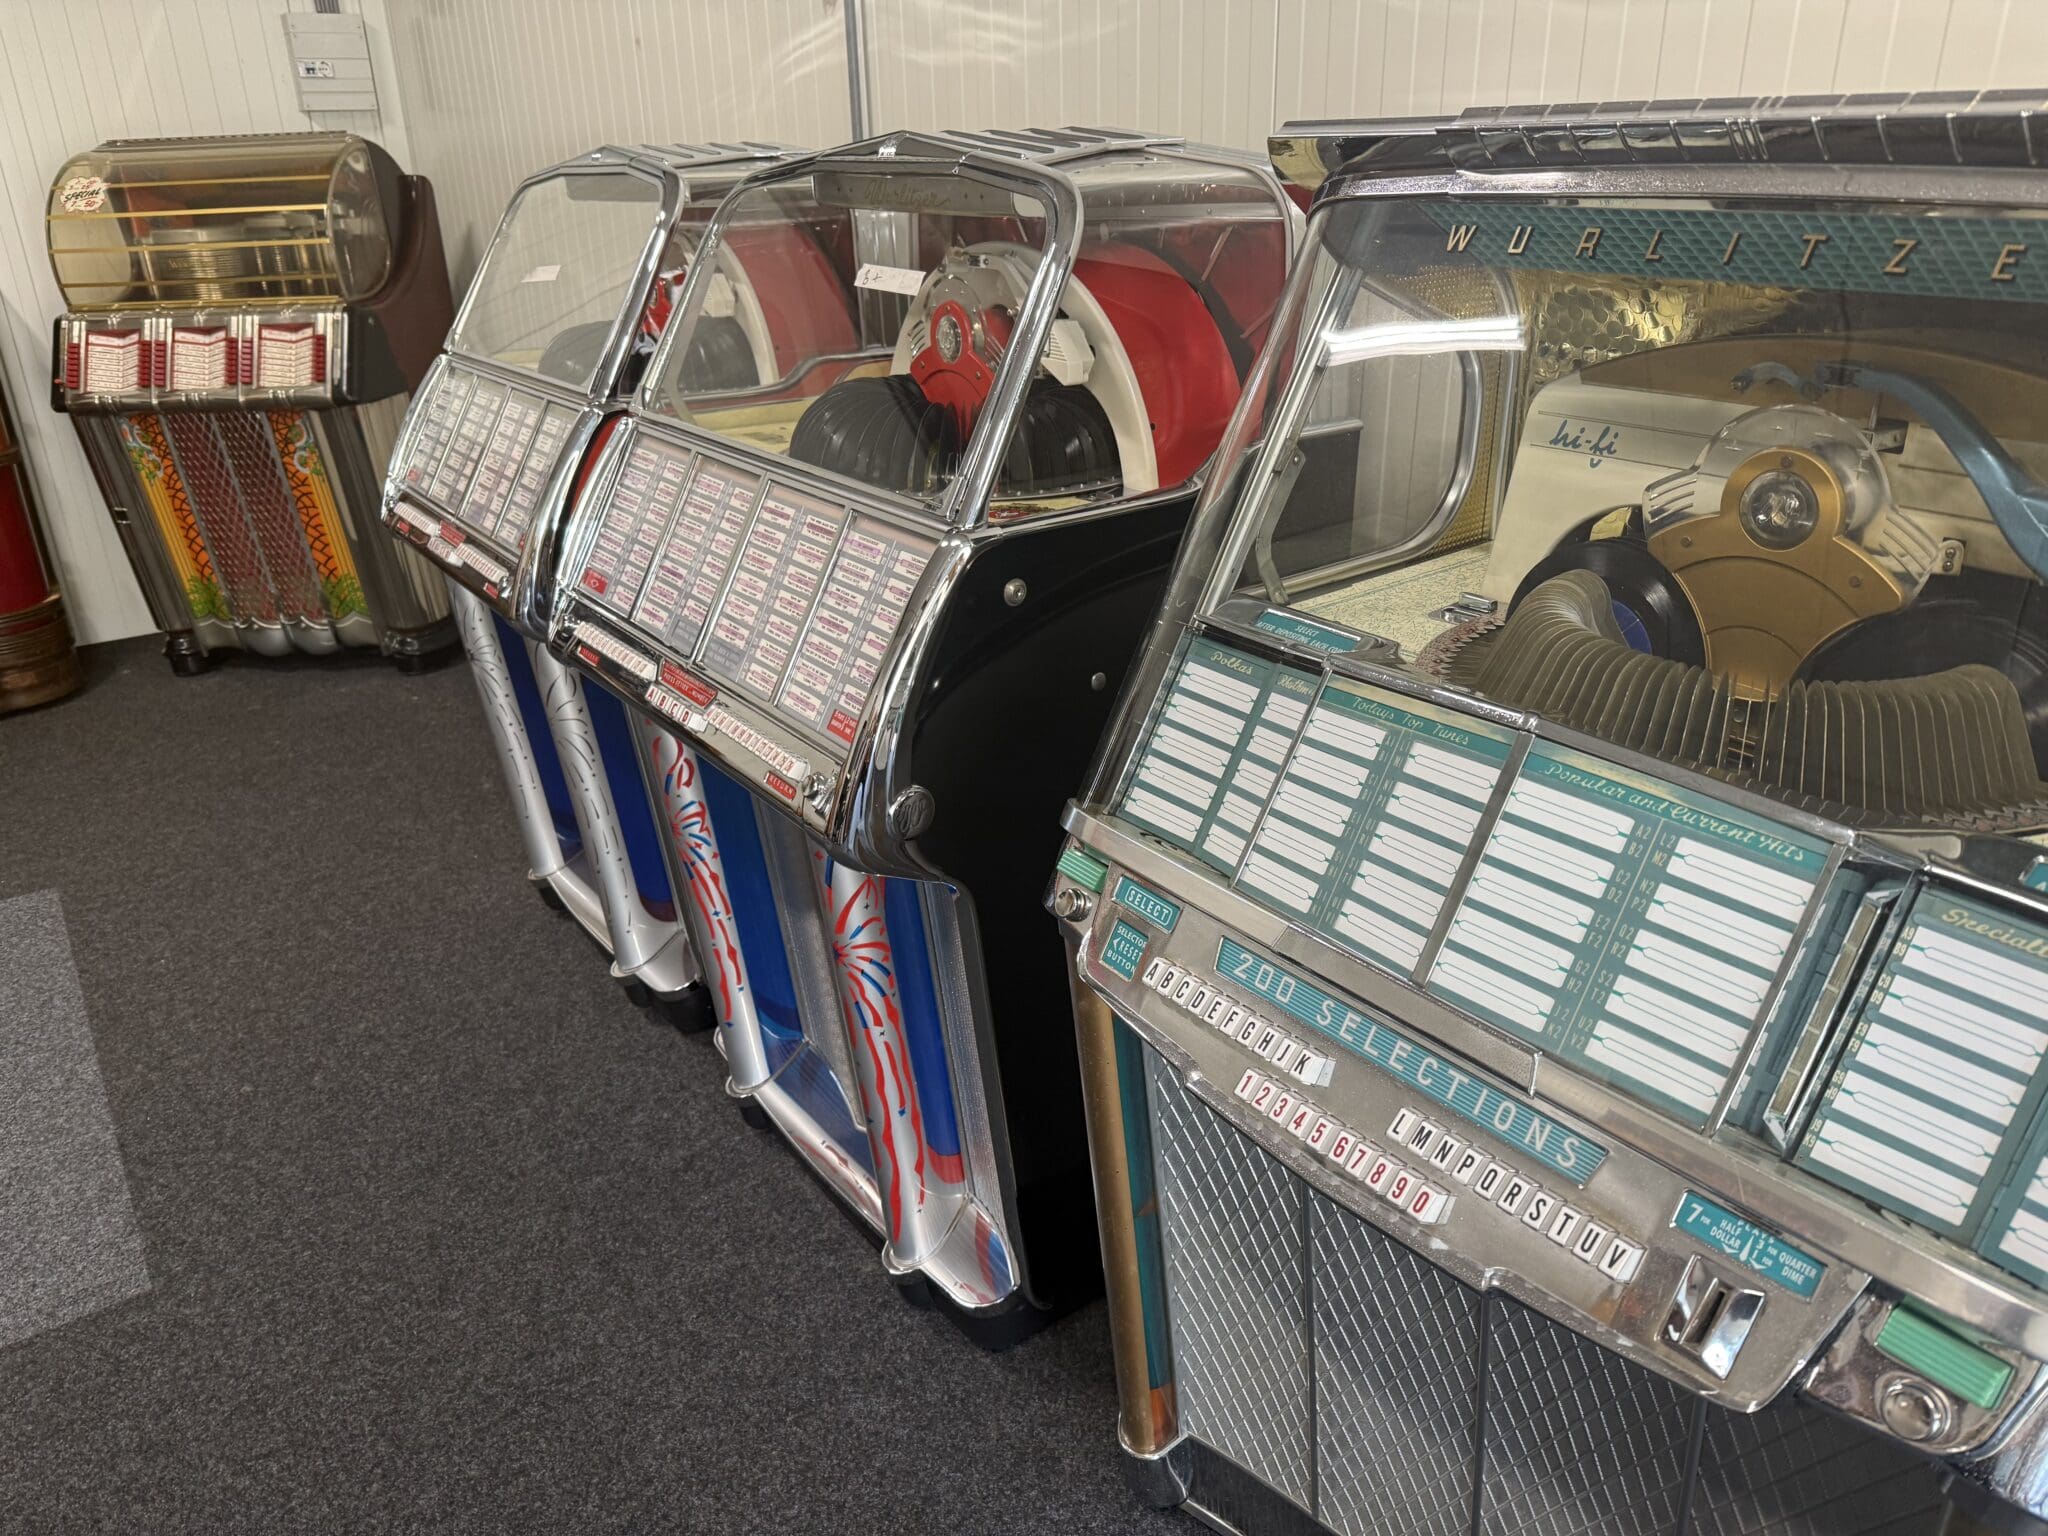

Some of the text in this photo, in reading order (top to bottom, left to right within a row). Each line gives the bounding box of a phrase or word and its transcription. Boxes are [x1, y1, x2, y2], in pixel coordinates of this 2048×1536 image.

[64, 187, 101, 202] SPECIAL
[1549, 419, 1619, 469] hi-fi
[1275, 628, 1311, 643] DEPOSITING
[1294, 624, 1319, 637] SELECT
[1210, 651, 1253, 675] Polkas
[1402, 713, 1424, 729] Top
[1432, 723, 1469, 745] Tunes
[1544, 762, 1805, 862] Popular and Current Hits
[1636, 824, 1651, 840] A2
[1660, 832, 1676, 849] L2
[1628, 842, 1643, 858] B2
[1652, 850, 1667, 867] M2
[1616, 869, 1631, 885] C2
[1640, 879, 1654, 894] N2
[1128, 890, 1169, 920] SELECT
[1631, 897, 1646, 912] P2
[1596, 914, 1611, 930] E2
[1117, 926, 1147, 949] SELECTOR
[1587, 932, 1602, 948] F2
[1901, 926, 1915, 940] A9
[1118, 941, 1142, 962] RESET
[1611, 942, 1626, 958] R2
[1893, 942, 1907, 956] B9
[1107, 950, 1136, 973] BUTTON
[1575, 960, 1590, 976] G2
[1598, 970, 1613, 986] S2
[1878, 974, 1892, 988] C9
[1591, 987, 1605, 1004] T2
[1554, 1005, 1569, 1021] J2
[1547, 1023, 1562, 1039] K2
[1578, 1016, 1593, 1032] U2
[1848, 1038, 1861, 1053] F9
[1234, 953, 1580, 1168] 200 SELECTIONS
[1810, 1118, 1823, 1132] J9
[1686, 1203, 1704, 1223] 7
[1720, 1219, 1742, 1237] HALF
[1710, 1226, 1741, 1250] DOLLAR
[1756, 1239, 1765, 1250] 3
[1779, 1252, 1817, 1280] QUARTER
[1781, 1266, 1805, 1285] DIME
